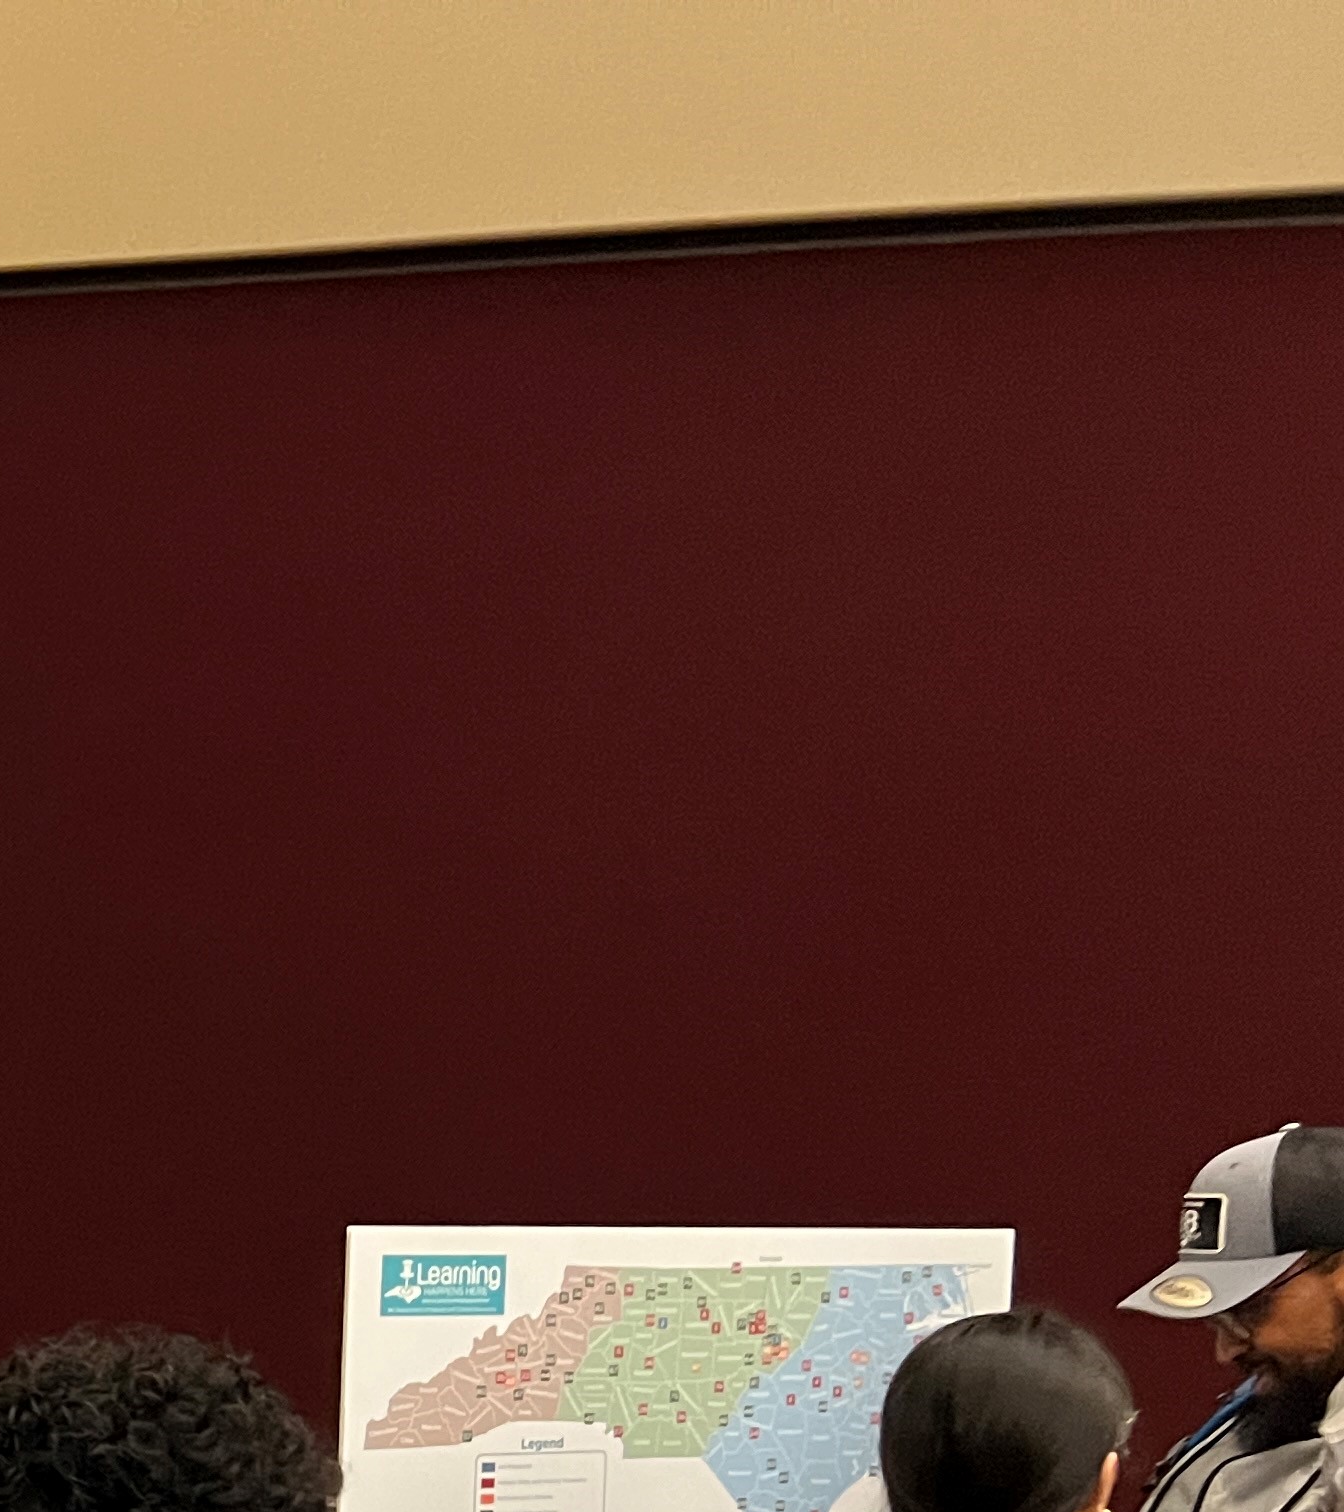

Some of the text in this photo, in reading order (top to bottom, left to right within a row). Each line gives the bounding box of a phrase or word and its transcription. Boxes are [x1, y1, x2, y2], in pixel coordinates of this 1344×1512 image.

[417, 1260, 501, 1290] Learning
[423, 1287, 463, 1296] HAPPENS
[521, 1437, 564, 1451] Legend
